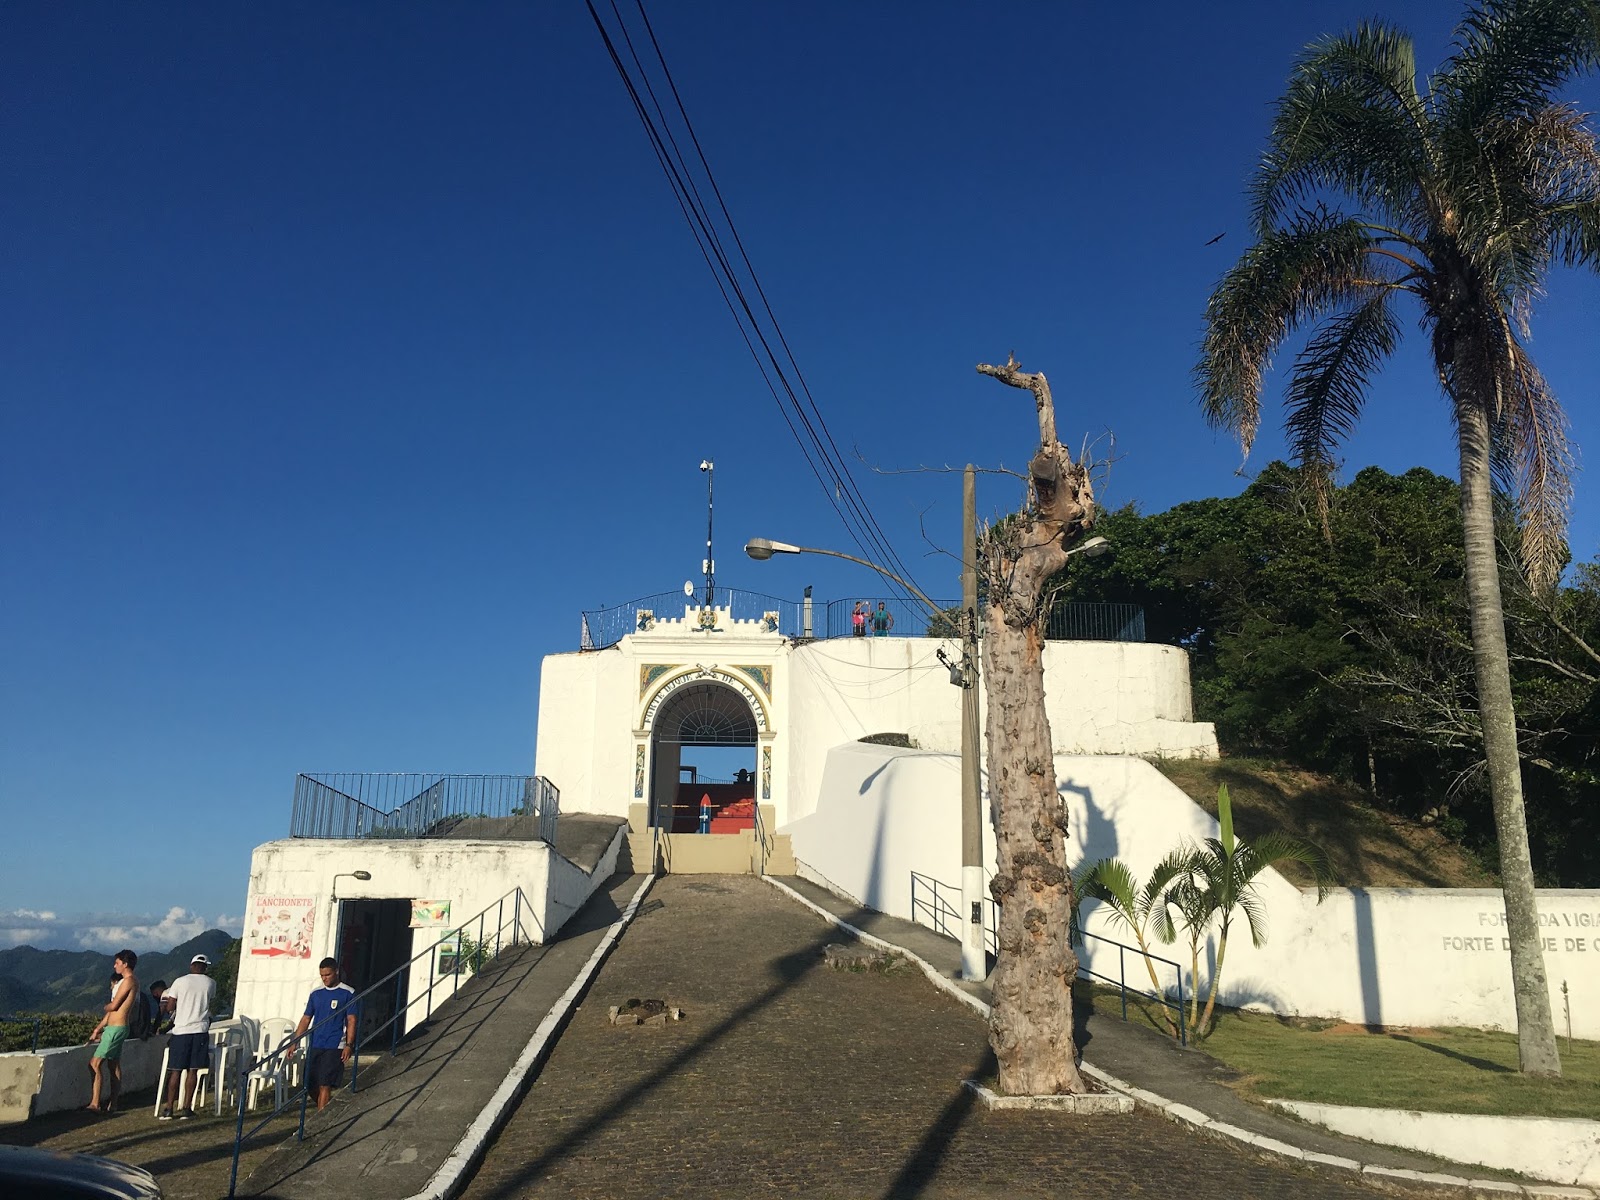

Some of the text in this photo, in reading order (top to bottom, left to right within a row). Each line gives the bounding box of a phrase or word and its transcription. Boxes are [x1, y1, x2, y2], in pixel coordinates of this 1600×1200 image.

[644, 674, 767, 727] FORTE DUQUE DE CAXIAS
[256, 898, 313, 907] LANCHONETE
[1442, 936, 1495, 951] FORTE
[1564, 937, 1587, 952] DE
